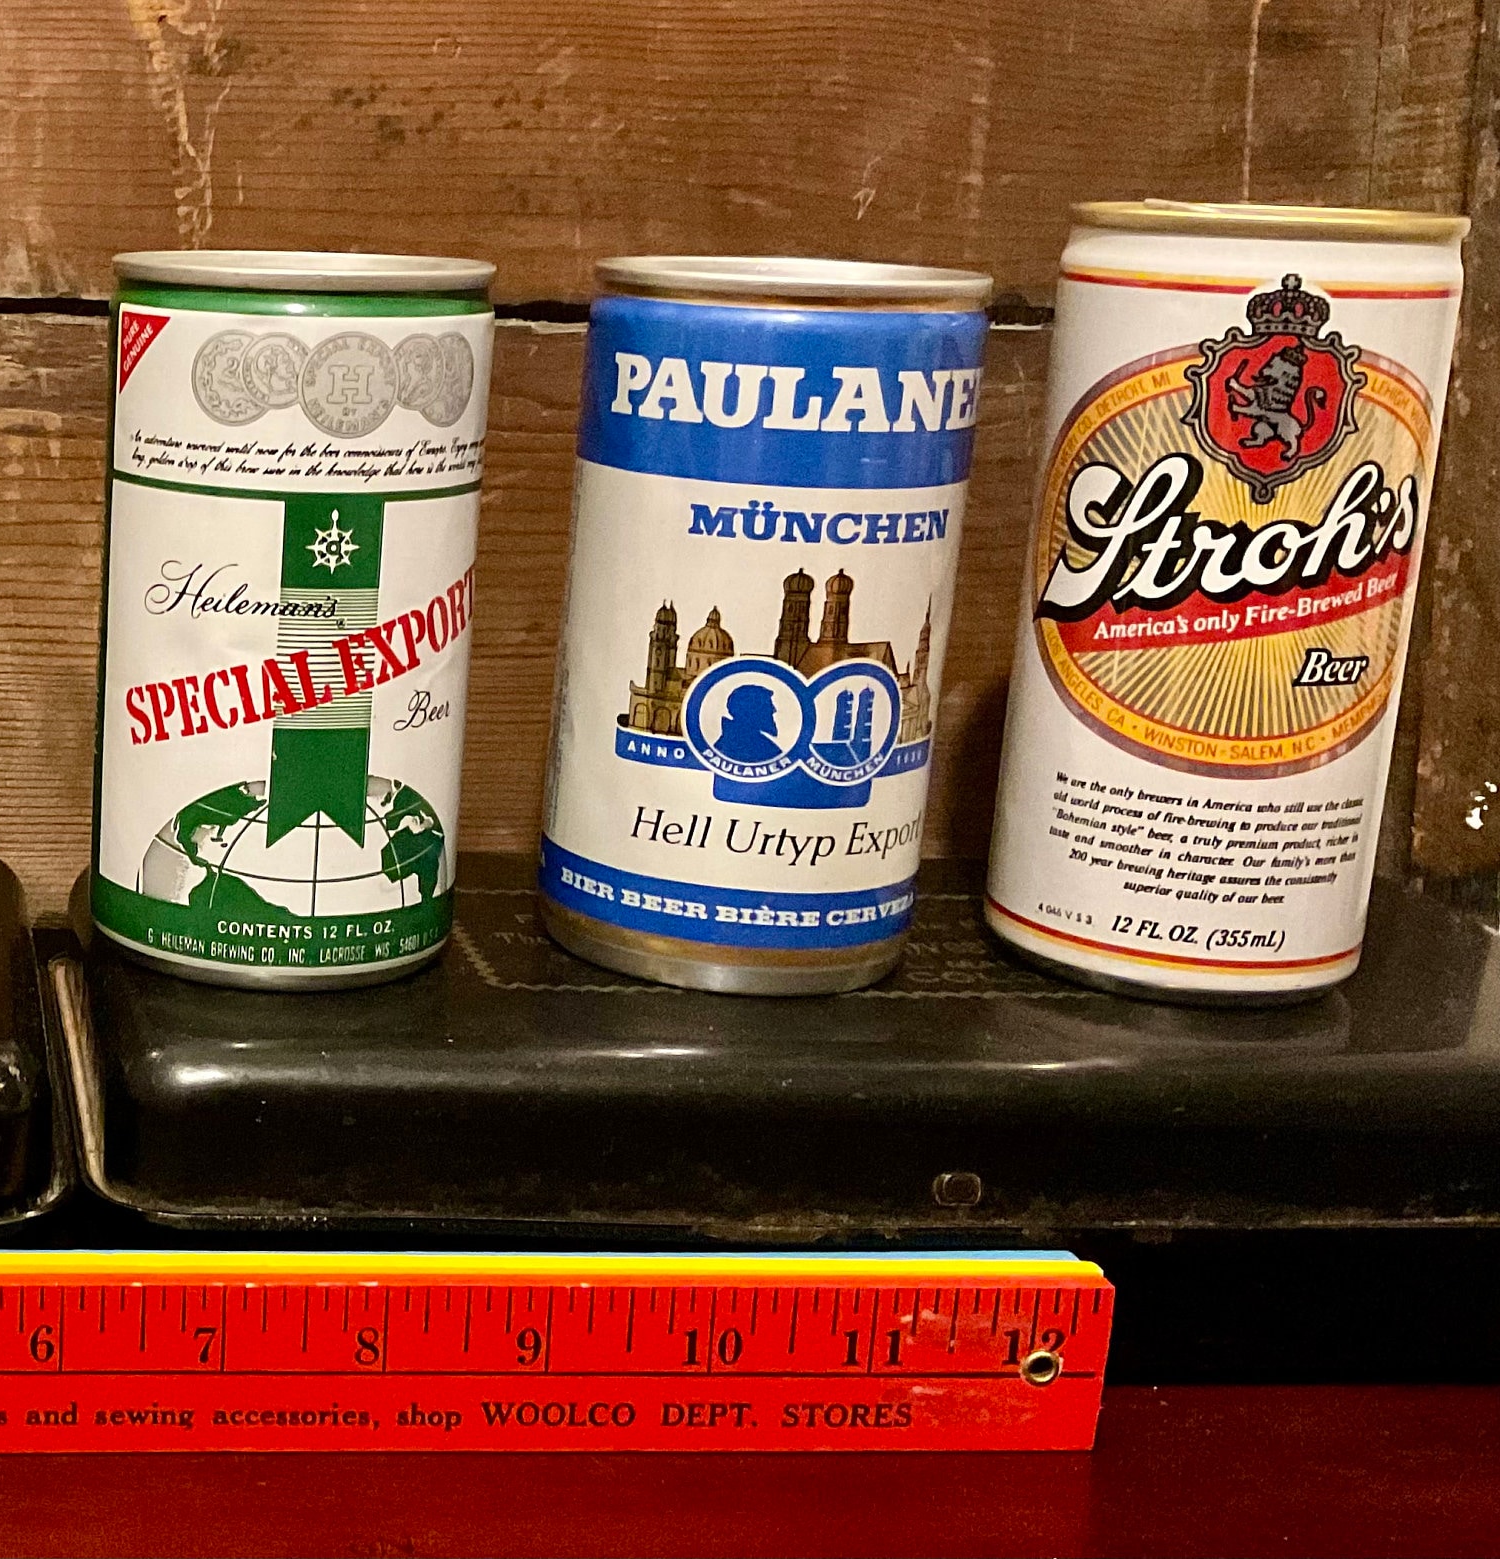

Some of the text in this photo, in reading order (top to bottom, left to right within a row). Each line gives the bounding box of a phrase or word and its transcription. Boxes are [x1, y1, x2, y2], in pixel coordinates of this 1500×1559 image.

[123, 319, 154, 372] PURE GENUINE
[611, 351, 984, 433] PAULANE
[687, 500, 949, 545] MÜNCHEN
[1035, 451, 1419, 621] Stroh's
[144, 560, 337, 619] Heileman's
[1093, 573, 1398, 639] America's only Fire-Brewed Beer
[125, 565, 475, 745] SPECIAL EXPORT
[1294, 648, 1369, 687] Beer
[392, 689, 451, 731] Beer
[627, 740, 686, 759] ANNO
[701, 748, 793, 777] PAULANER
[806, 753, 885, 782] MÜNCHEN
[1056, 771, 1252, 812] We are the only brewers in America
[1102, 804, 1143, 818] process
[1147, 810, 1162, 820] of
[631, 806, 712, 848] Hell
[725, 818, 836, 866] Urtyp
[1100, 840, 1153, 856] smoother
[1193, 835, 1222, 849] truly
[1225, 838, 1278, 850] premium
[1117, 860, 1164, 879] brewing
[560, 867, 614, 901] BIER
[621, 889, 708, 920] BEER
[715, 904, 820, 927] BIÈRE
[1123, 881, 1218, 904] superior quality
[161, 932, 205, 953] HEILEMAN
[210, 942, 254, 962] BREWING
[320, 946, 364, 962] LACROSSE
[217, 920, 395, 940] CONTENTS 12 FL. OZ.
[1110, 914, 1285, 952] 12 FL. OZ. (355mL)
[29, 1325, 55, 1363] 6
[193, 1326, 217, 1364] 7
[354, 1326, 381, 1367] 8
[515, 1327, 542, 1367] 9
[682, 1327, 745, 1366] 10
[843, 1329, 902, 1366] 11
[25, 1402, 79, 1426] and
[95, 1402, 194, 1430] sewing
[213, 1403, 380, 1430] accessories,
[397, 1403, 463, 1431] shop
[481, 1402, 636, 1427] WOOLCO
[662, 1404, 758, 1427] DEPT.
[781, 1403, 912, 1429] STORES
